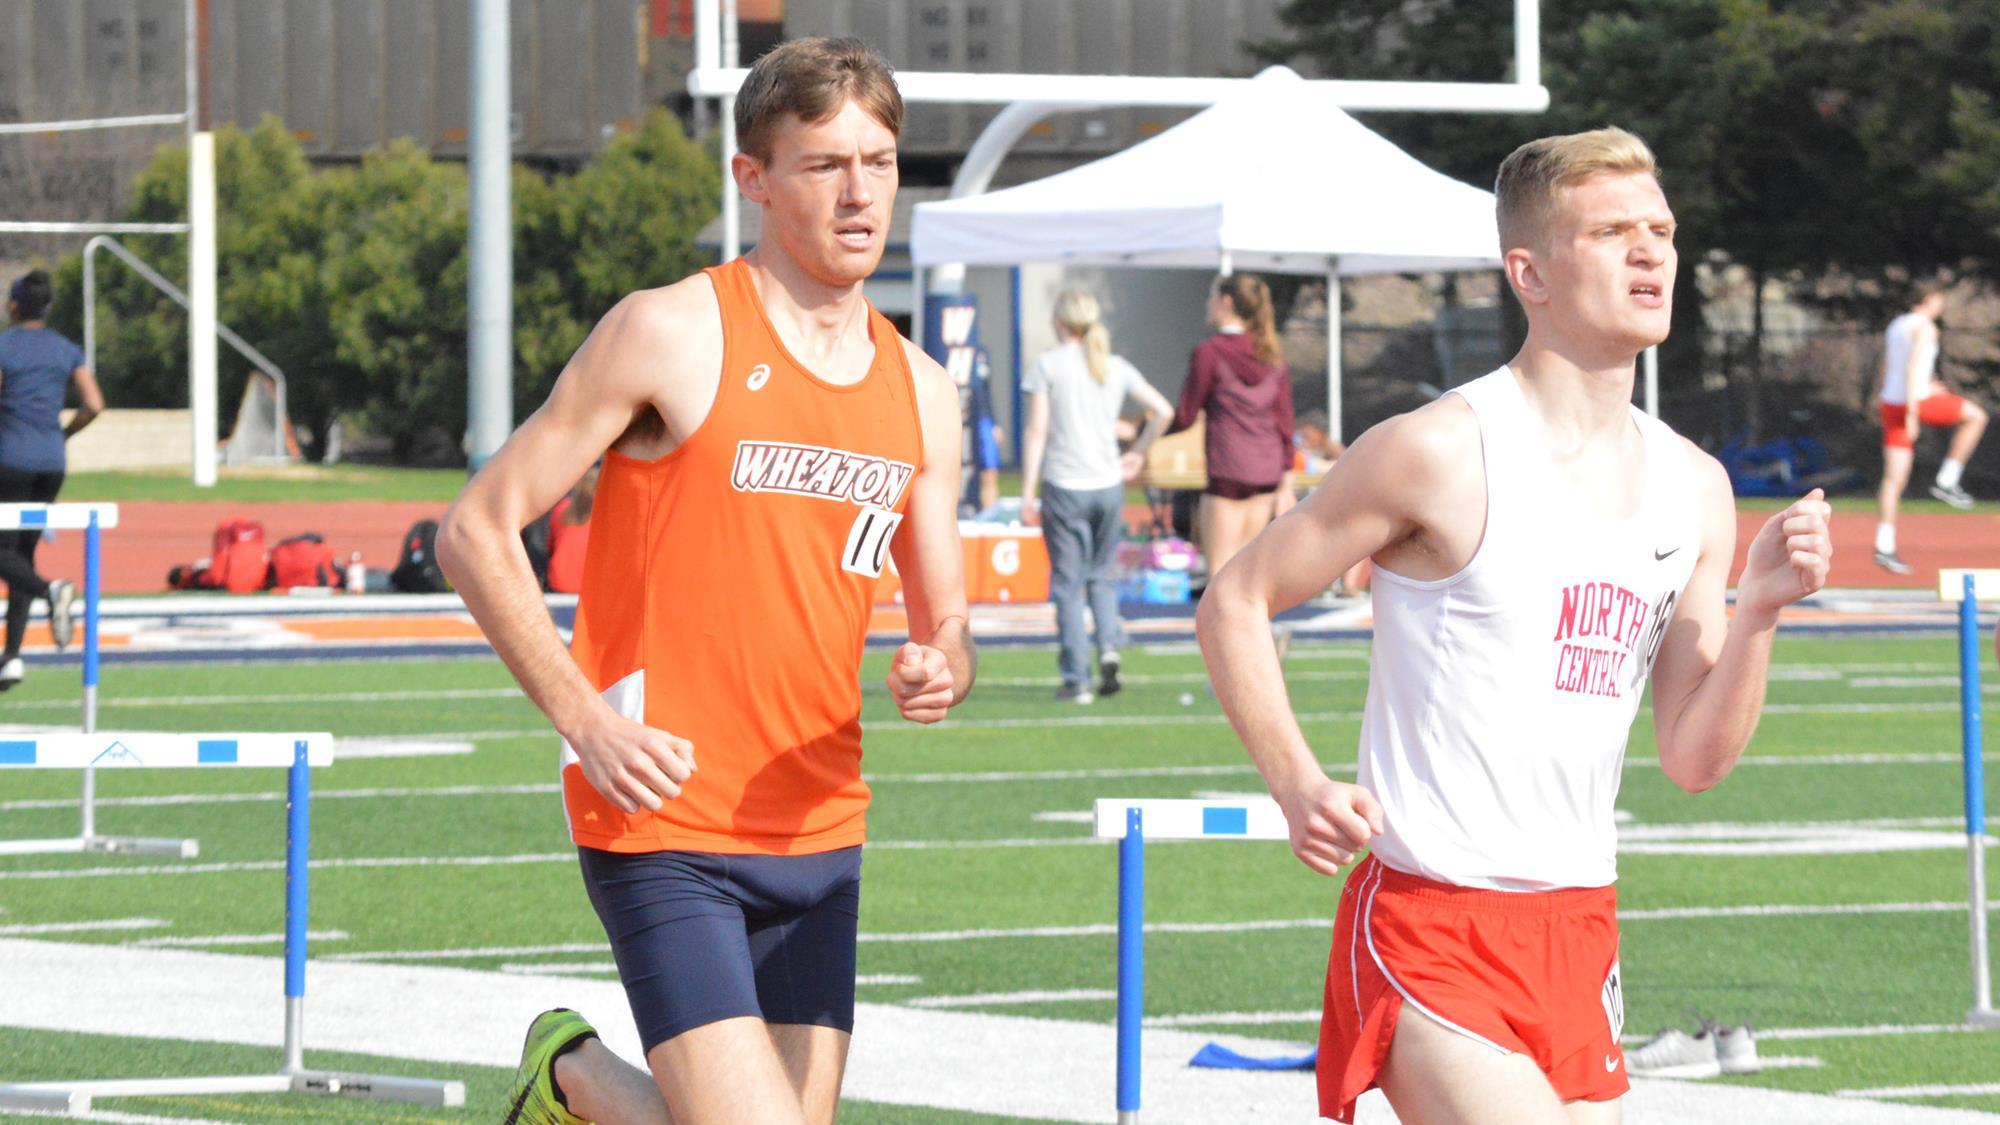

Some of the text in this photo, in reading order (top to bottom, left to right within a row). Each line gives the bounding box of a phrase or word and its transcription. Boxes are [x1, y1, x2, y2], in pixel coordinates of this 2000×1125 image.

[732, 441, 914, 511] WHEATON
[991, 539, 1020, 576] G
[1553, 582, 1648, 652] NORTH
[1555, 644, 1626, 698] CENTRAL
